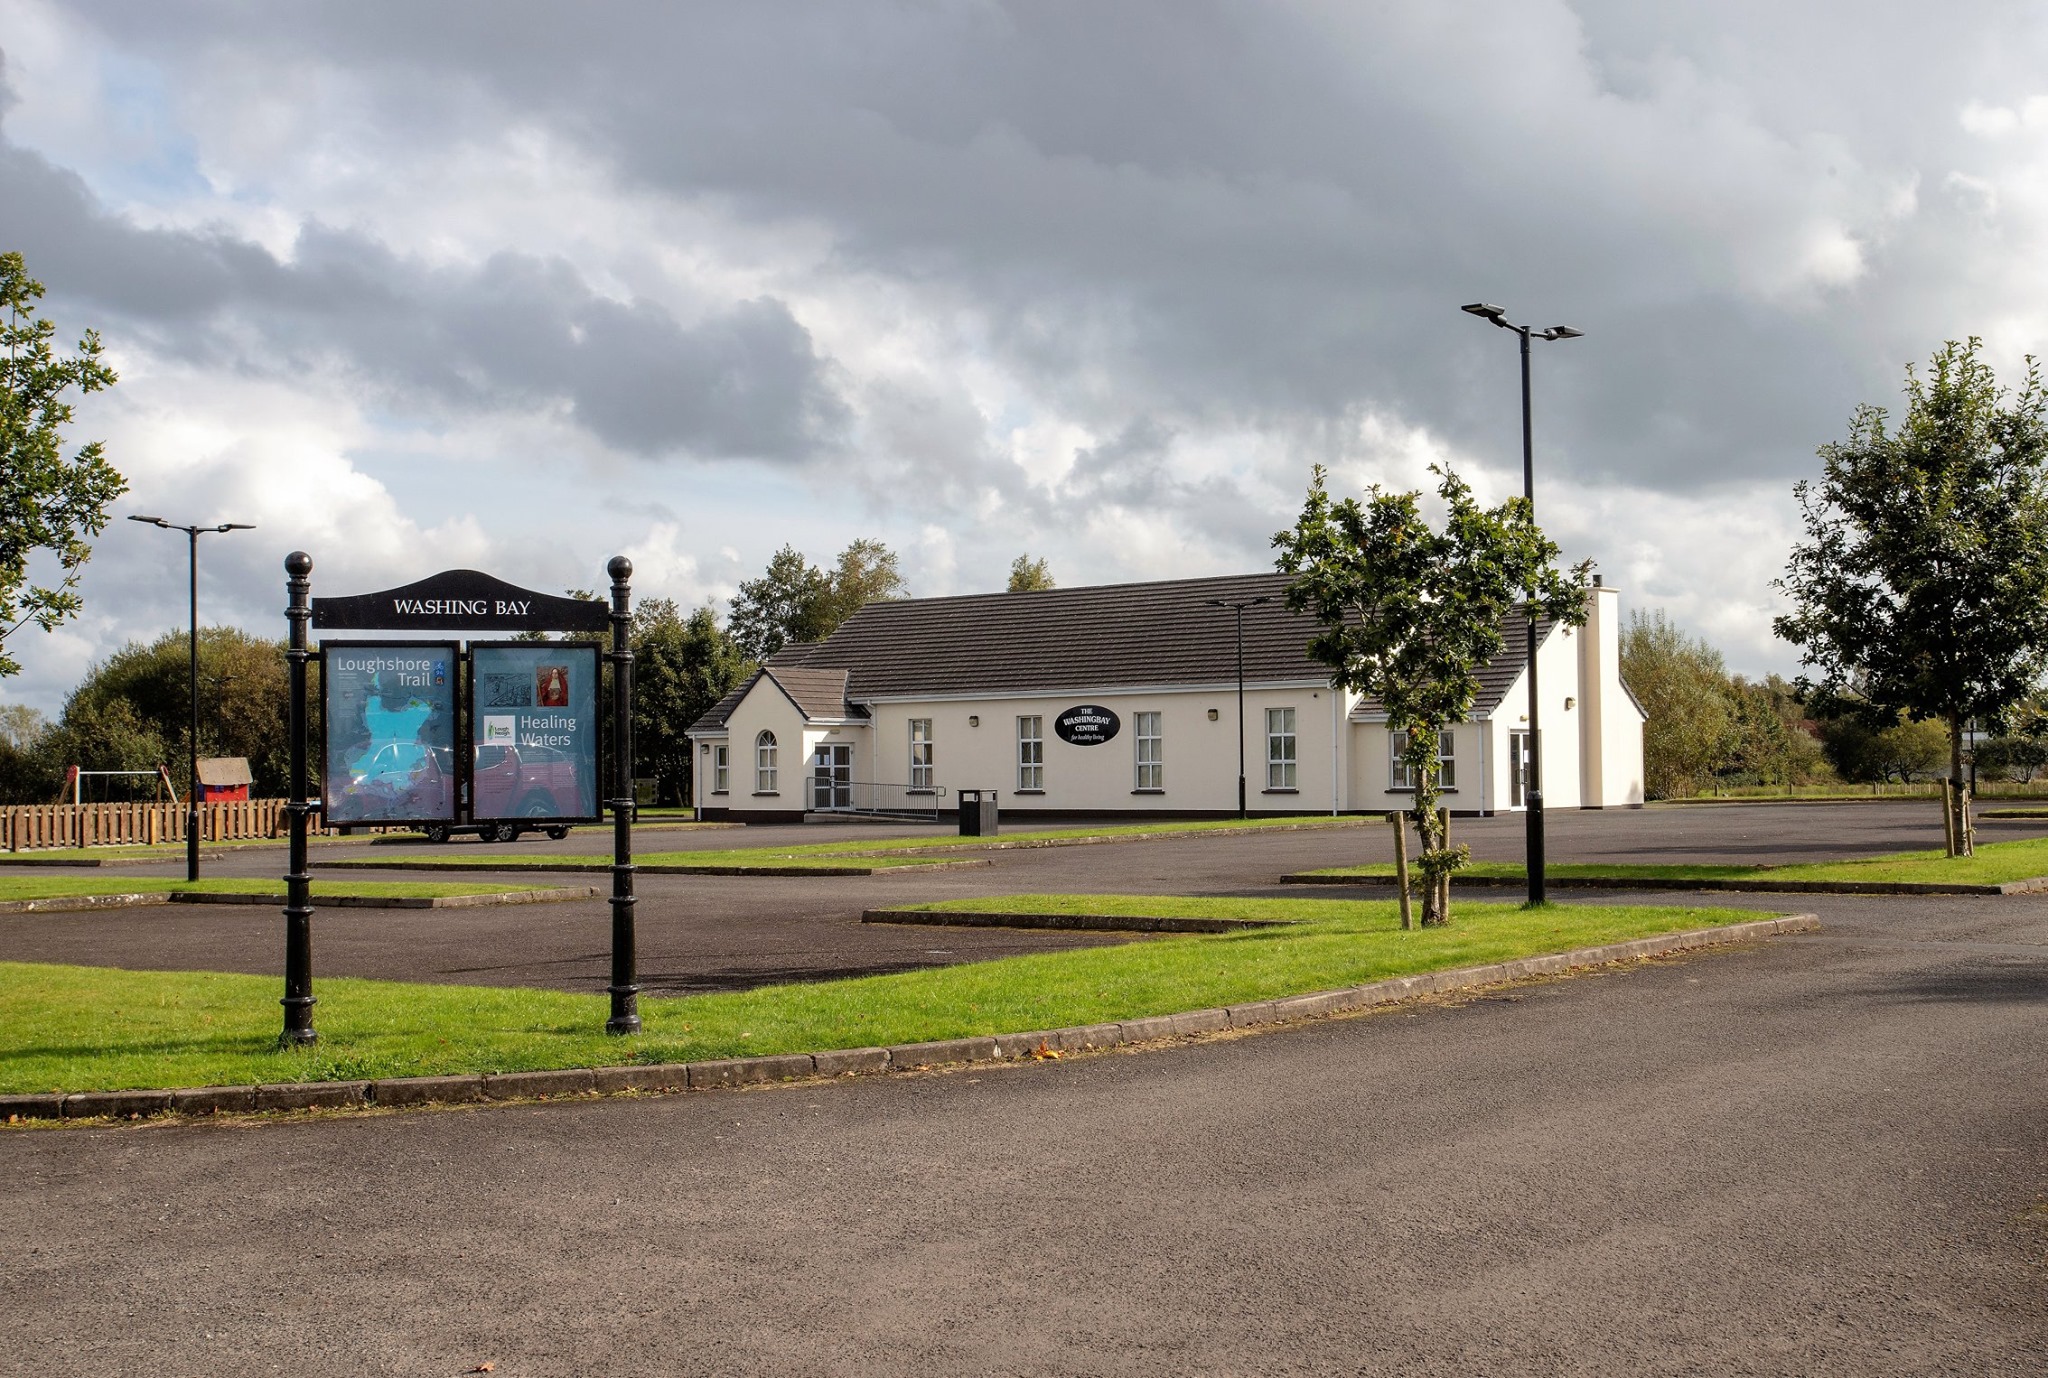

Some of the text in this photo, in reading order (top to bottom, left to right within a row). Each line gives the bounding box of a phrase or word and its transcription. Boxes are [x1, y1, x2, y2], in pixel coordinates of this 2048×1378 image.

[394, 599, 531, 615] WASHING BAY
[338, 657, 430, 673] Loughshore
[397, 673, 430, 686] Trail
[521, 715, 576, 731] Healing
[1063, 715, 1111, 726] WASHINGBAY
[521, 733, 571, 746] Waters
